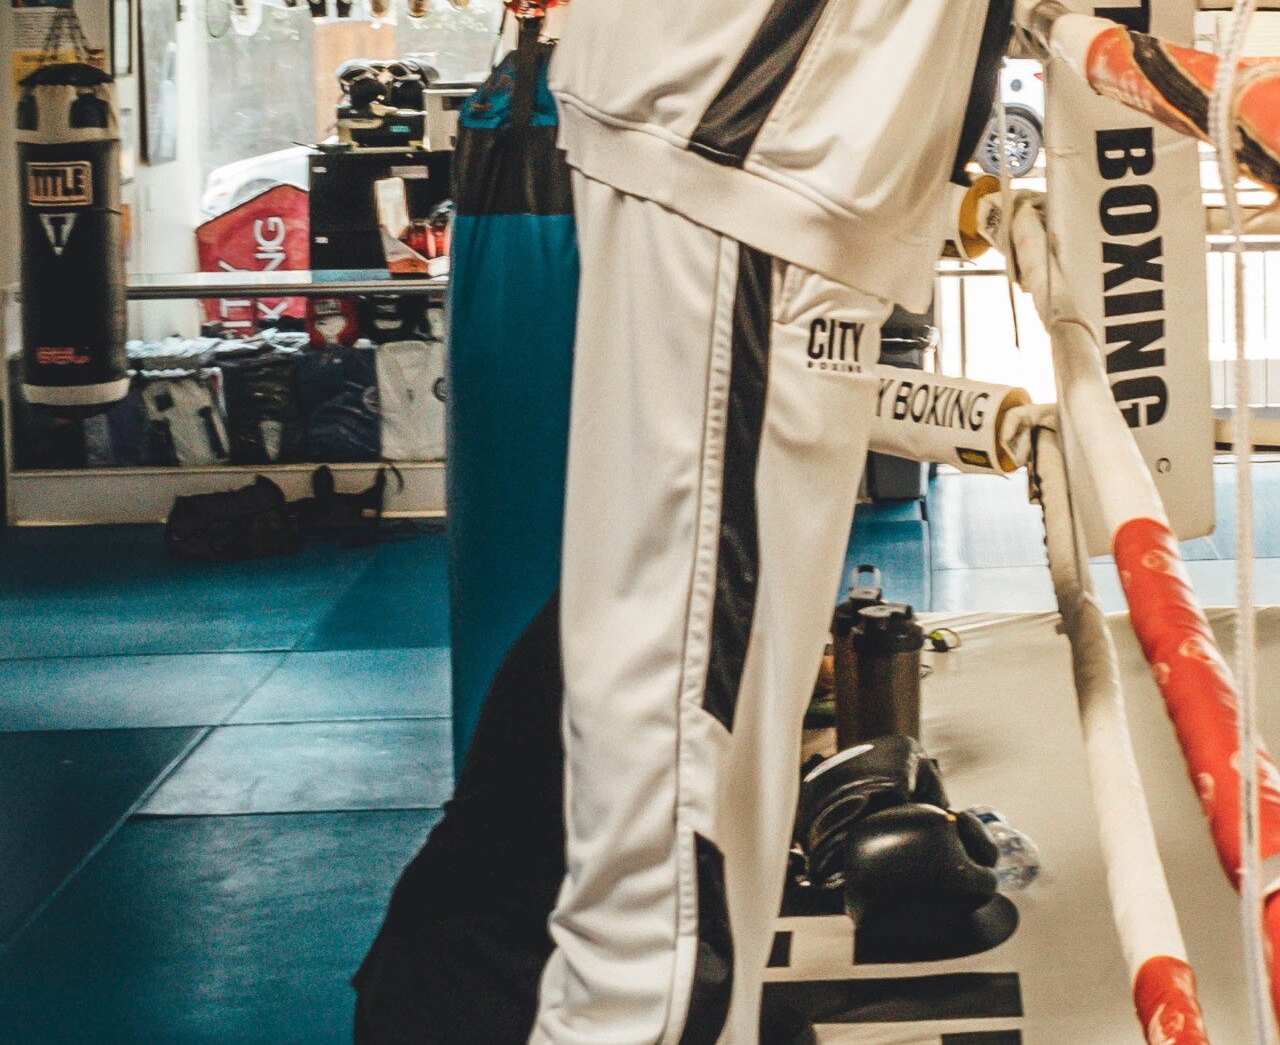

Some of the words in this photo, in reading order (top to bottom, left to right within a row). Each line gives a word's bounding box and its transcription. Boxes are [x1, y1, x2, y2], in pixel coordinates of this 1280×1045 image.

[1094, 126, 1170, 429] BOXING
[807, 317, 866, 363] CITY
[892, 381, 990, 432] BOXING
